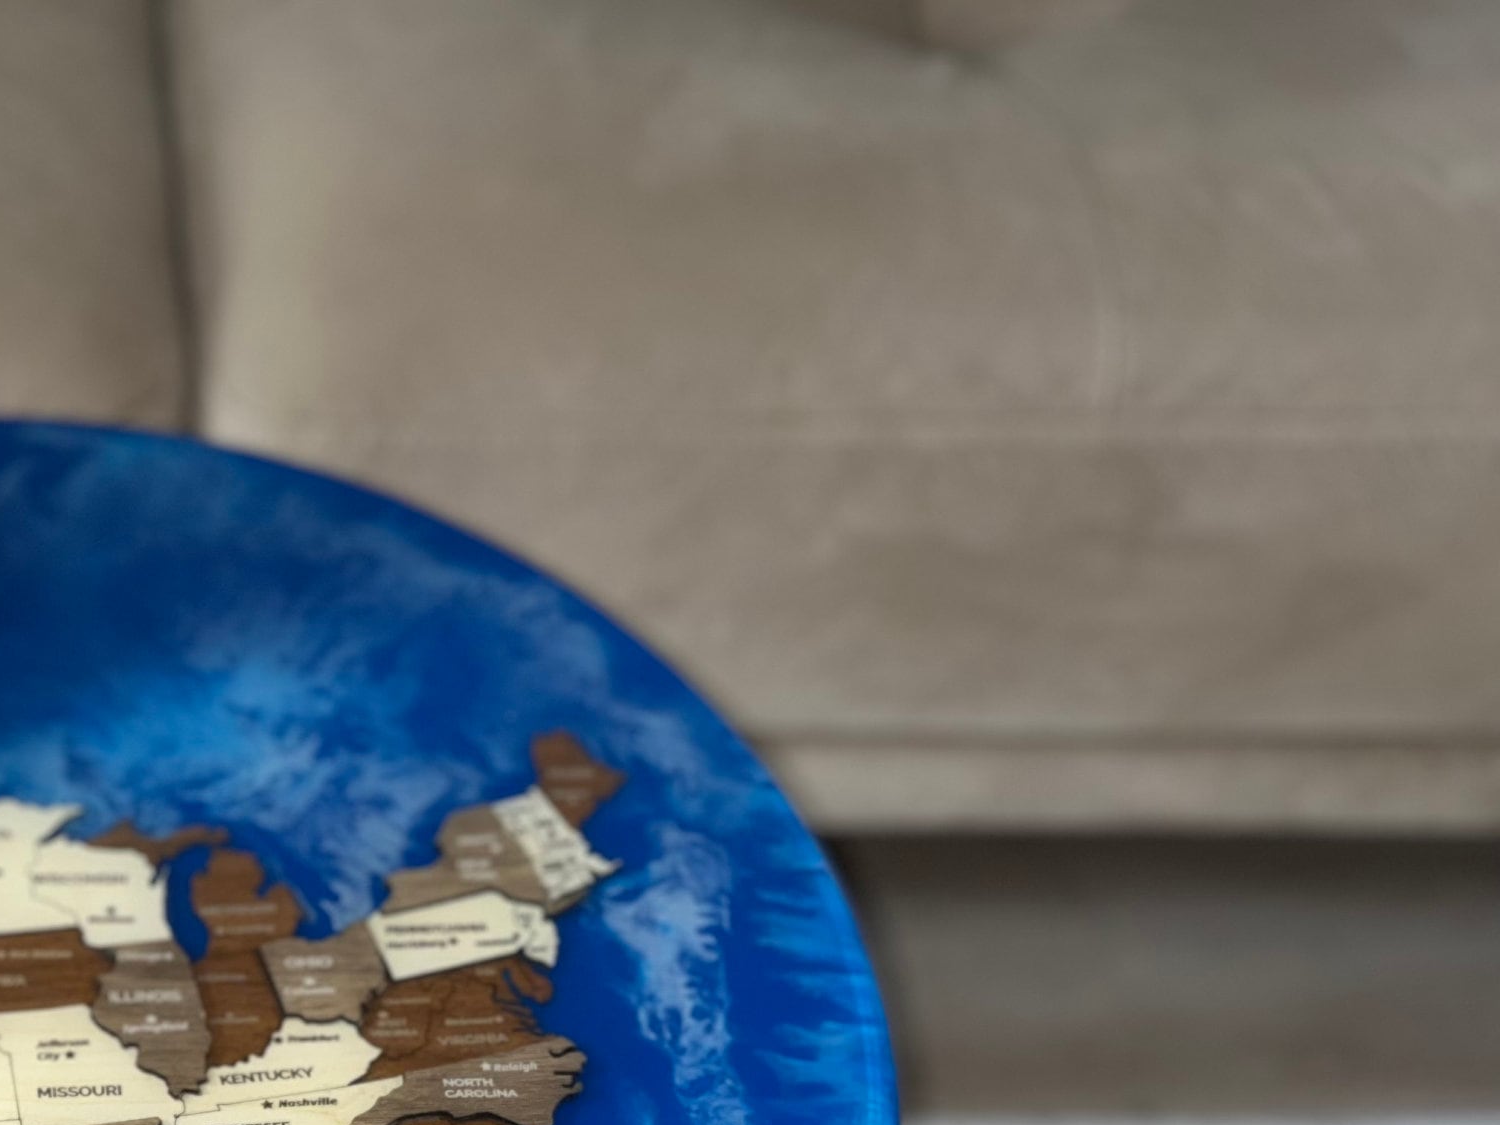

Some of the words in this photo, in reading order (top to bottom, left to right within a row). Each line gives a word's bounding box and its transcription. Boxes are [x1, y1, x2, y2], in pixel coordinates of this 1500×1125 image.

[219, 1067, 313, 1085] KENTUCKY
[443, 1077, 493, 1088] NORTH
[37, 1085, 123, 1098] MISSOURI
[444, 1088, 518, 1099] CAROLINA
[278, 1096, 337, 1108] Nashville
